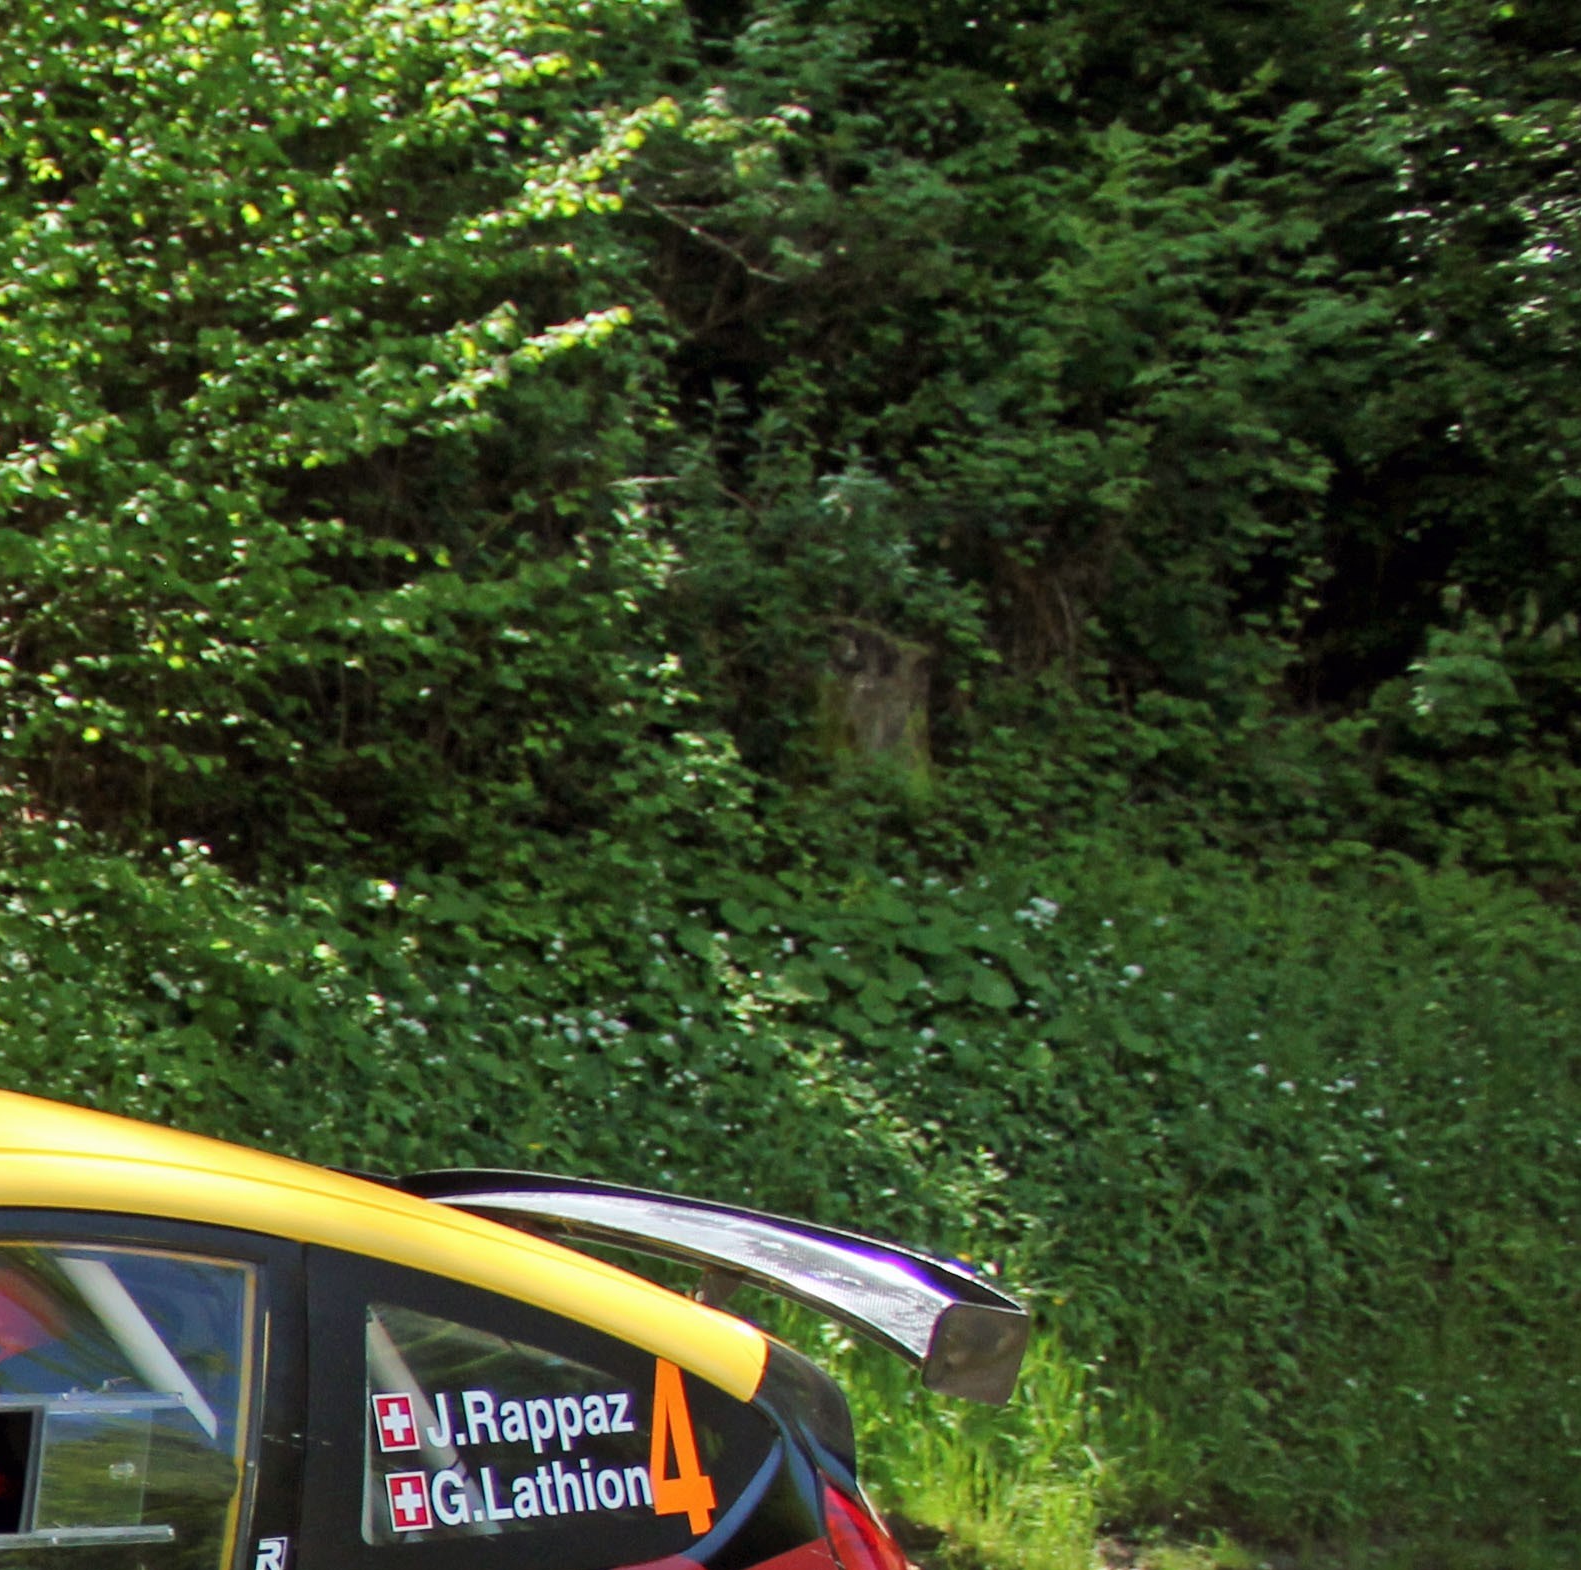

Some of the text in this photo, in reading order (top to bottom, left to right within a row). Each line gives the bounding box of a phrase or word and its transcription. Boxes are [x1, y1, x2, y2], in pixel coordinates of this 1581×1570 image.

[426, 1389, 635, 1454] J.Rappaz
[649, 1356, 716, 1536] 4
[430, 1458, 654, 1527] G.Lathion
